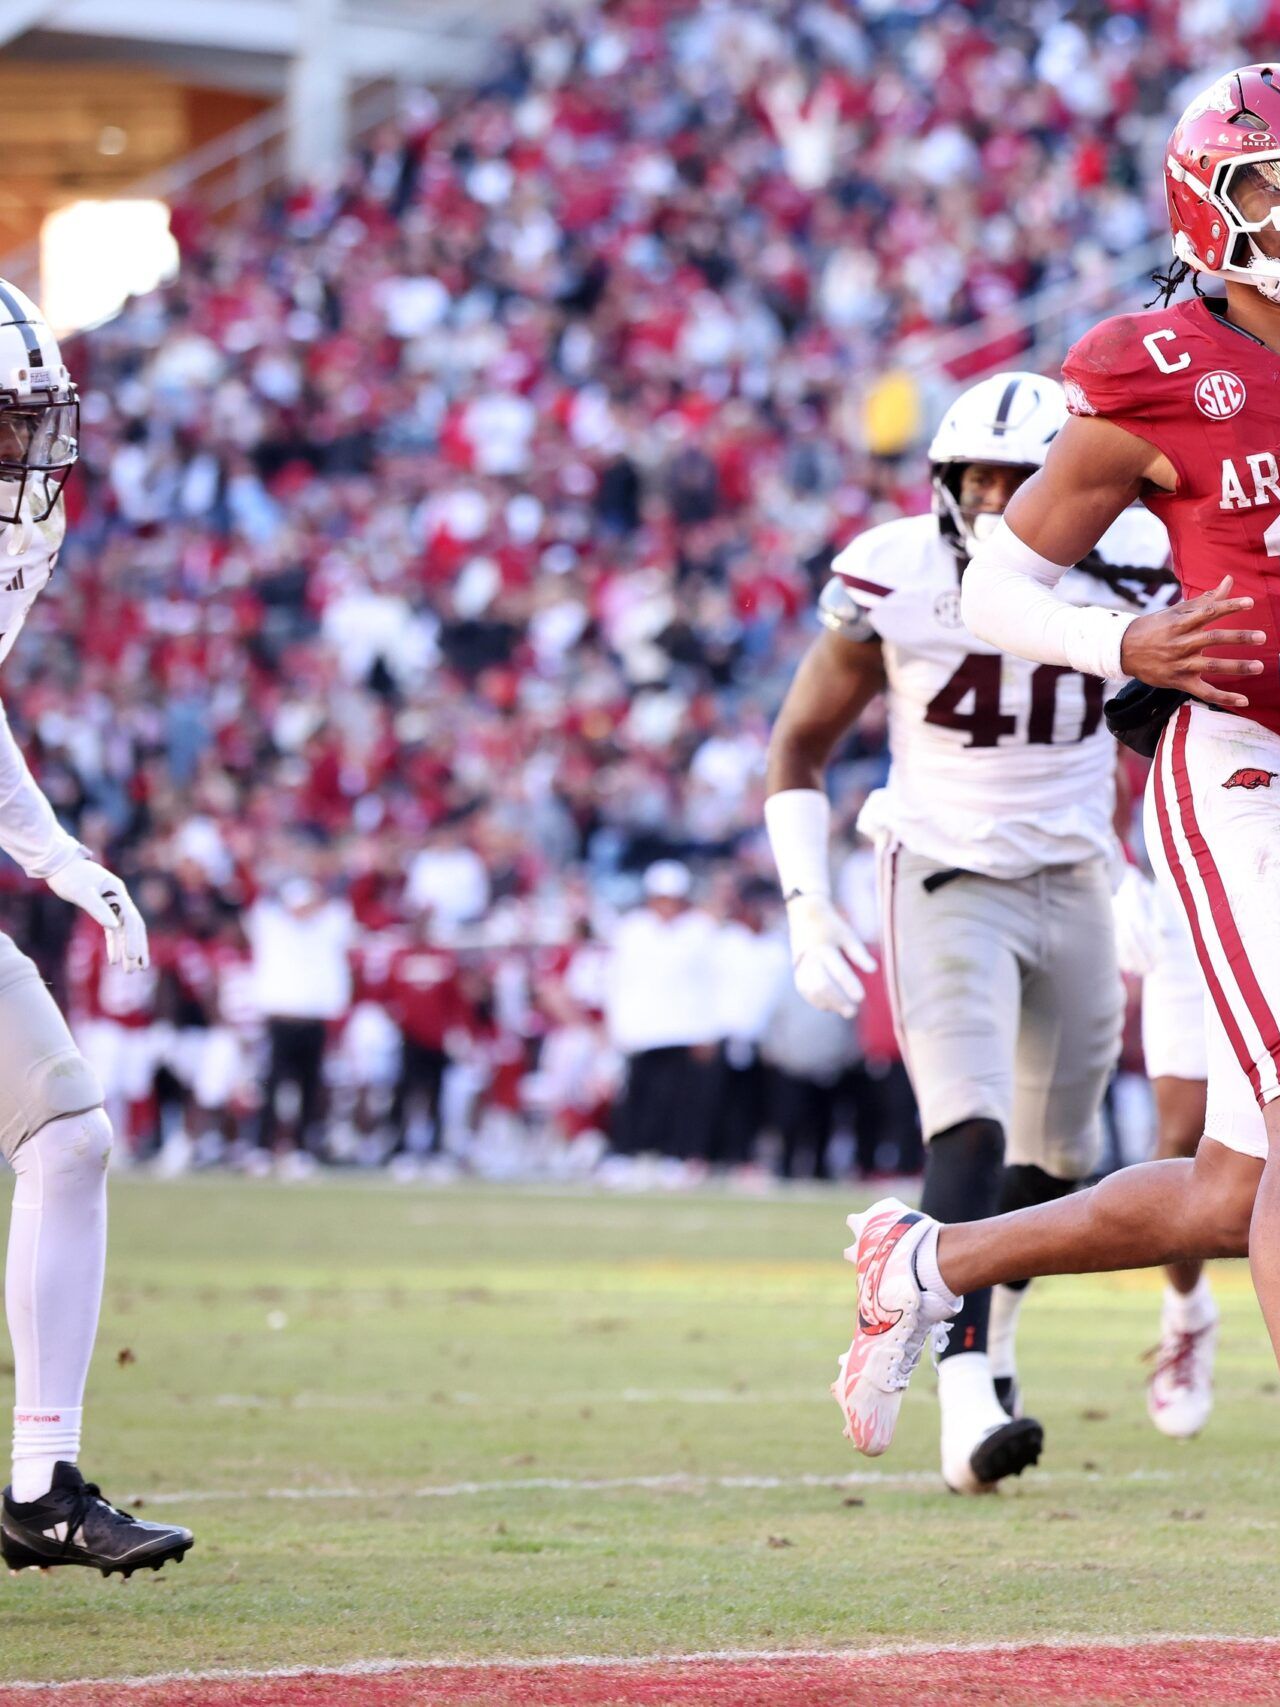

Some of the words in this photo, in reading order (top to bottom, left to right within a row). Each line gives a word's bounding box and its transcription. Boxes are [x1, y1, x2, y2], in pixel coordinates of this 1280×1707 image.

[1143, 329, 1191, 374] C
[1199, 374, 1242, 416] SEC
[924, 653, 1106, 747] 40
